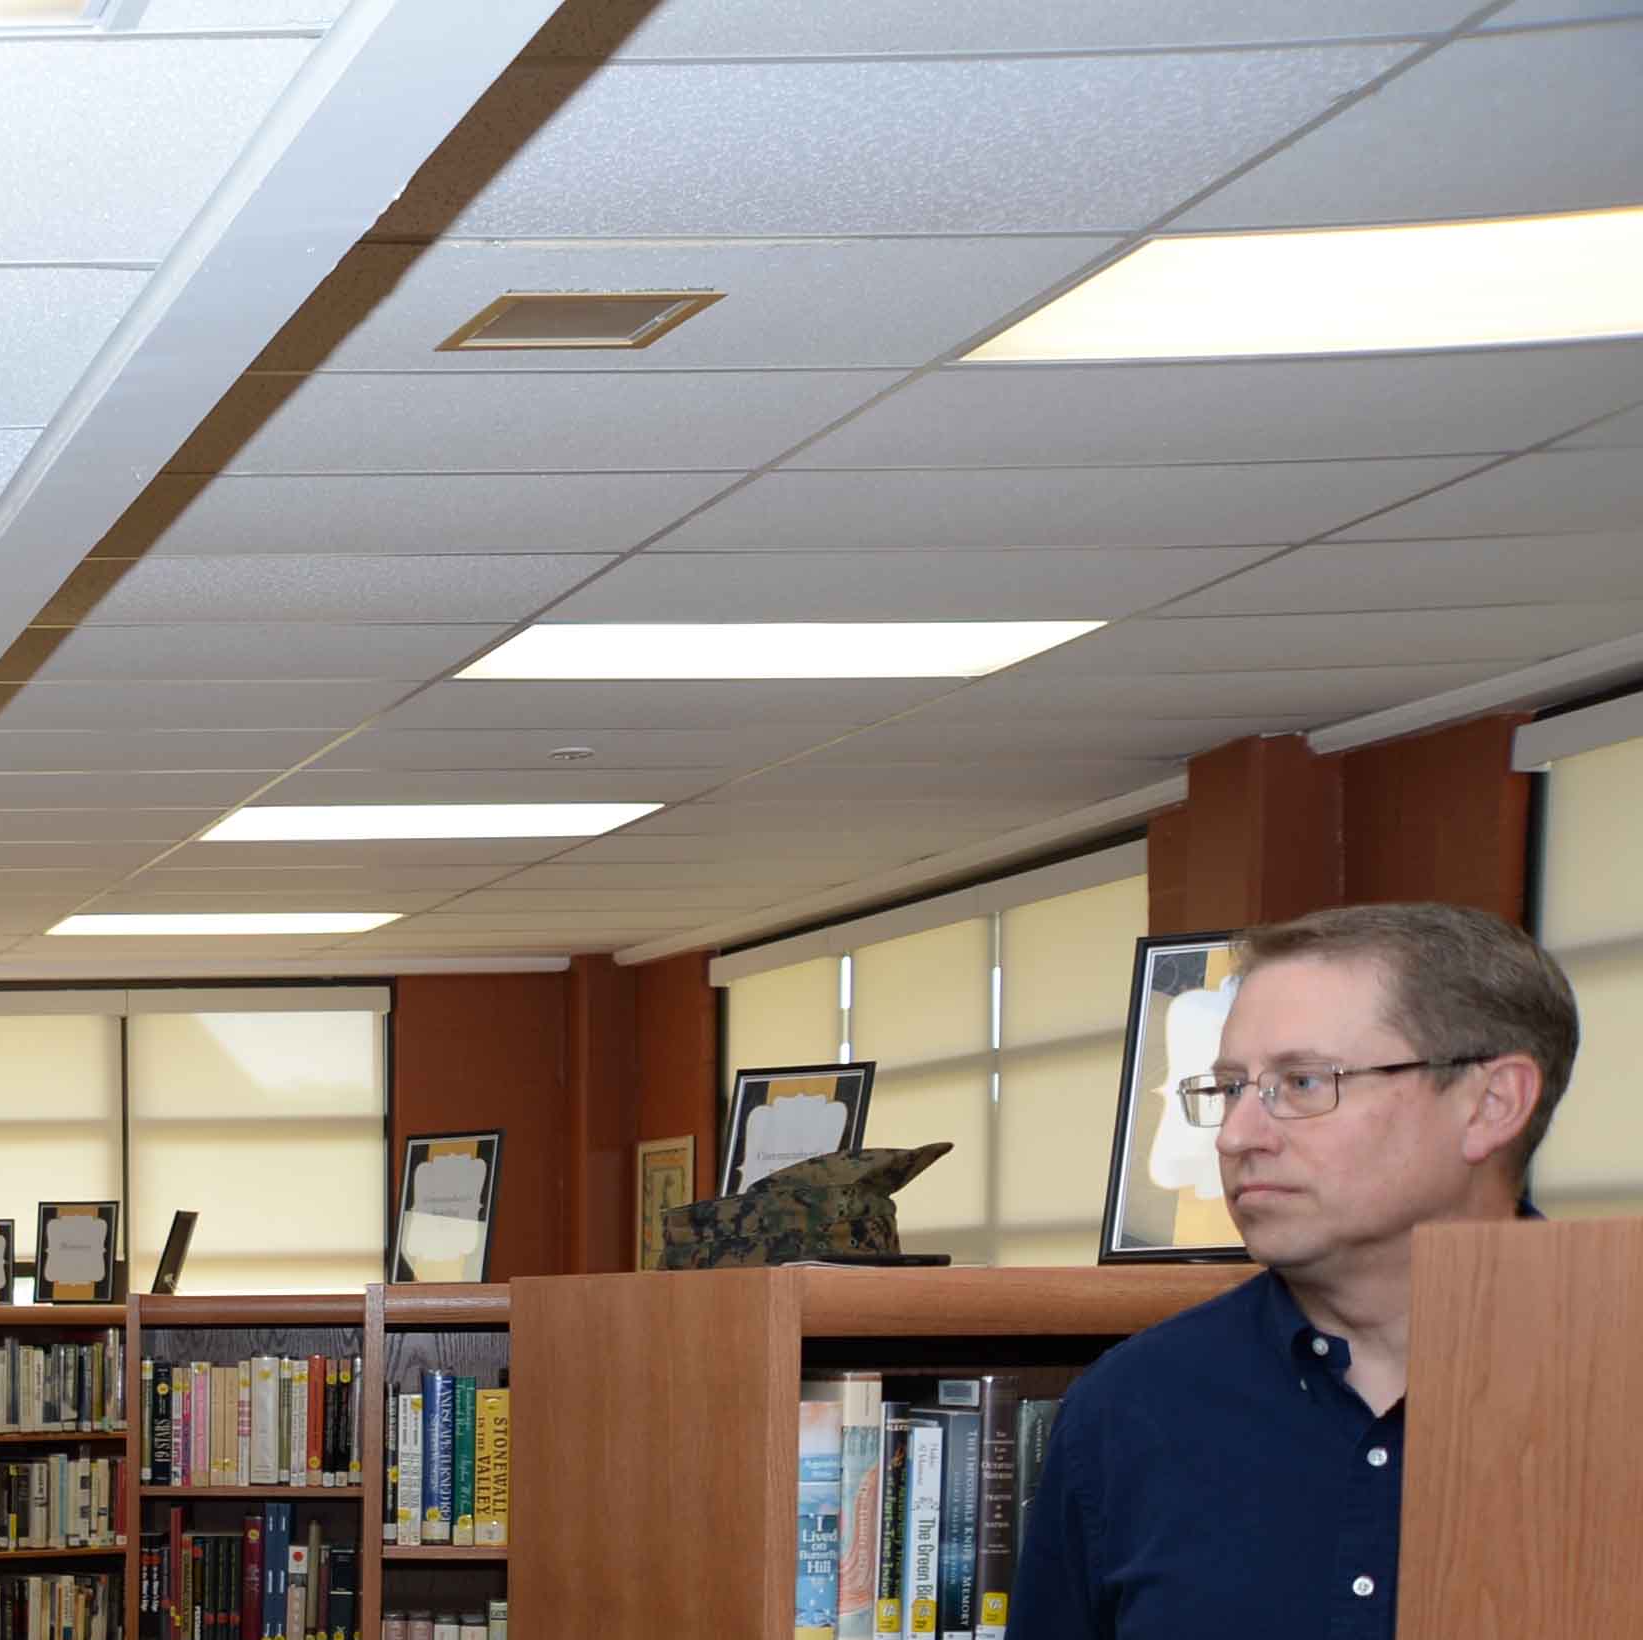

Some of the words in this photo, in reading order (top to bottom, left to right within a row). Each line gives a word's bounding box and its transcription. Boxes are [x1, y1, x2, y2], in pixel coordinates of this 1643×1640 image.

[967, 1431, 977, 1453] THE
[493, 1416, 508, 1516] STONEWALL
[477, 1455, 491, 1515] VALLEY
[964, 1456, 977, 1522] IMPOSSIBLE
[802, 1529, 838, 1543] Lived
[816, 1516, 823, 1531] I
[917, 1519, 935, 1540] The
[963, 1527, 975, 1562] KNIFE
[807, 1561, 831, 1574] Hill
[916, 1544, 933, 1581] Green
[960, 1576, 972, 1627] MEMORY
